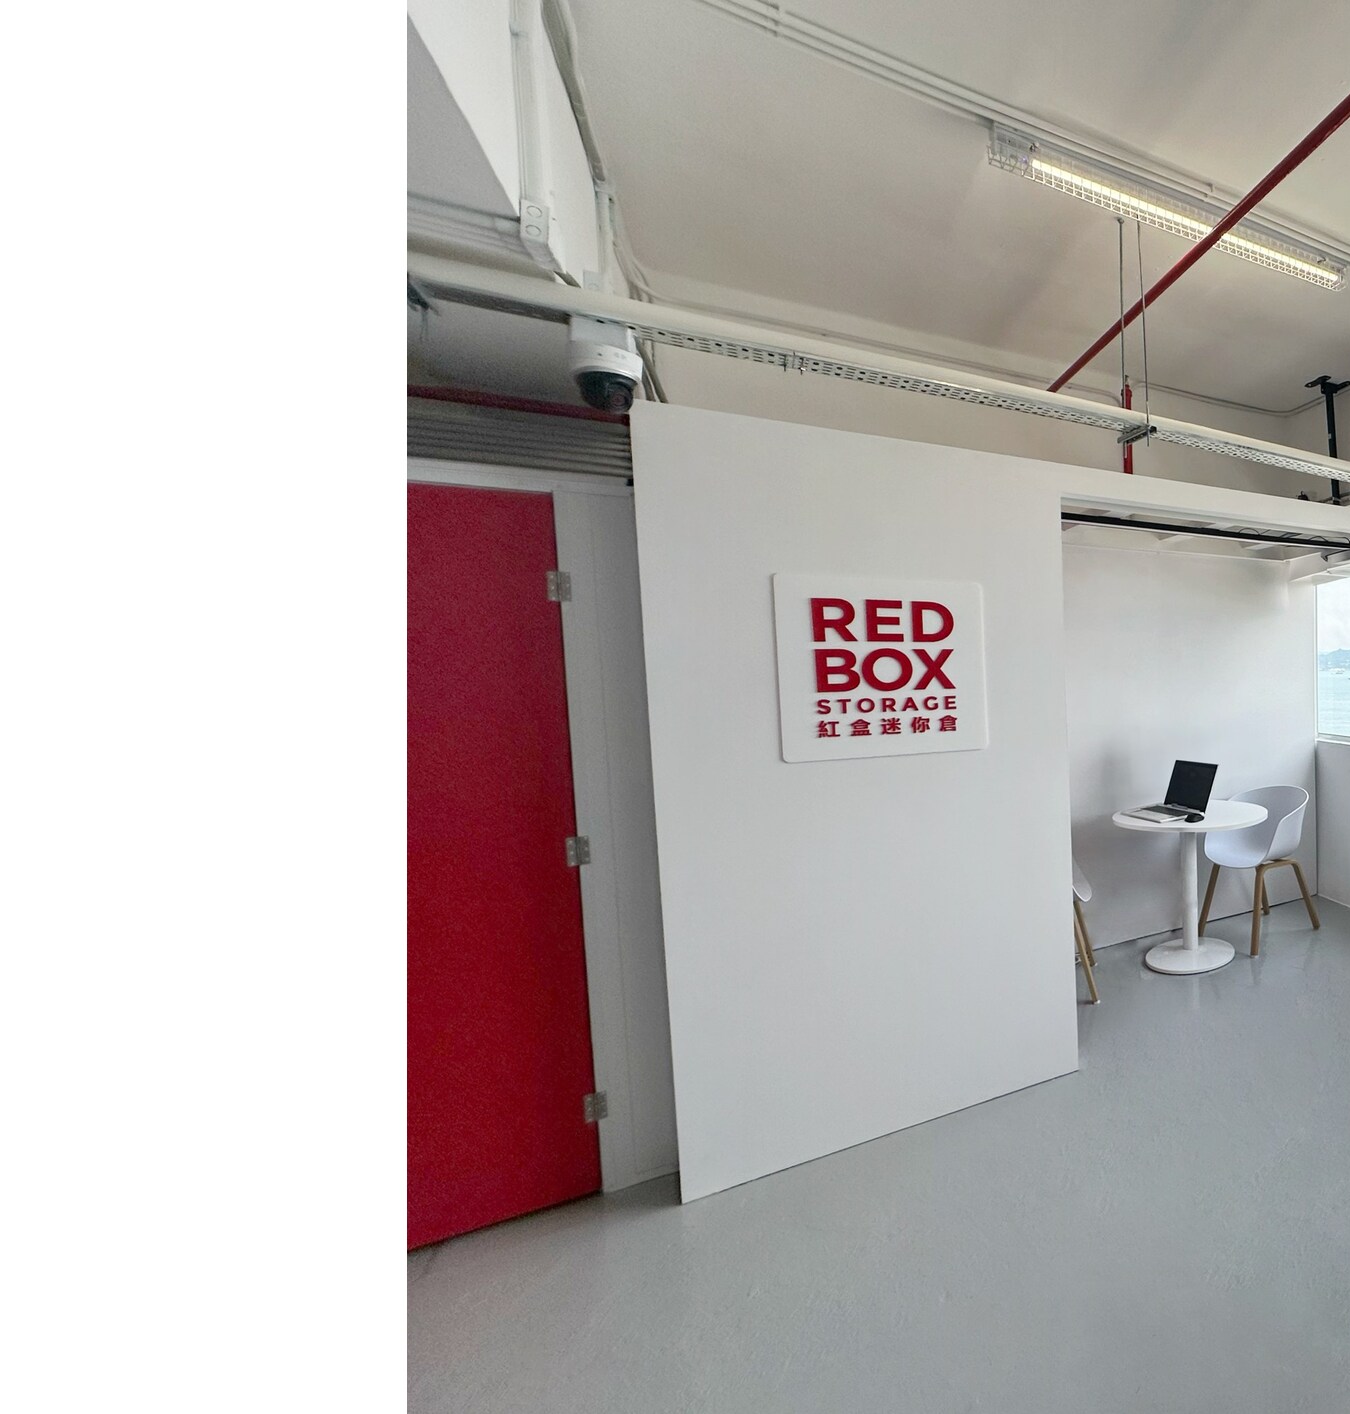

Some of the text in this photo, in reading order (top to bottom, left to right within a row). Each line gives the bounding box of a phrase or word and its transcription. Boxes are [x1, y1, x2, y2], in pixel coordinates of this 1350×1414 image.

[810, 597, 955, 643] RED
[814, 648, 957, 693] BOX
[816, 695, 957, 715] STORAGE
[816, 714, 958, 738] 紅盒迷你倉
